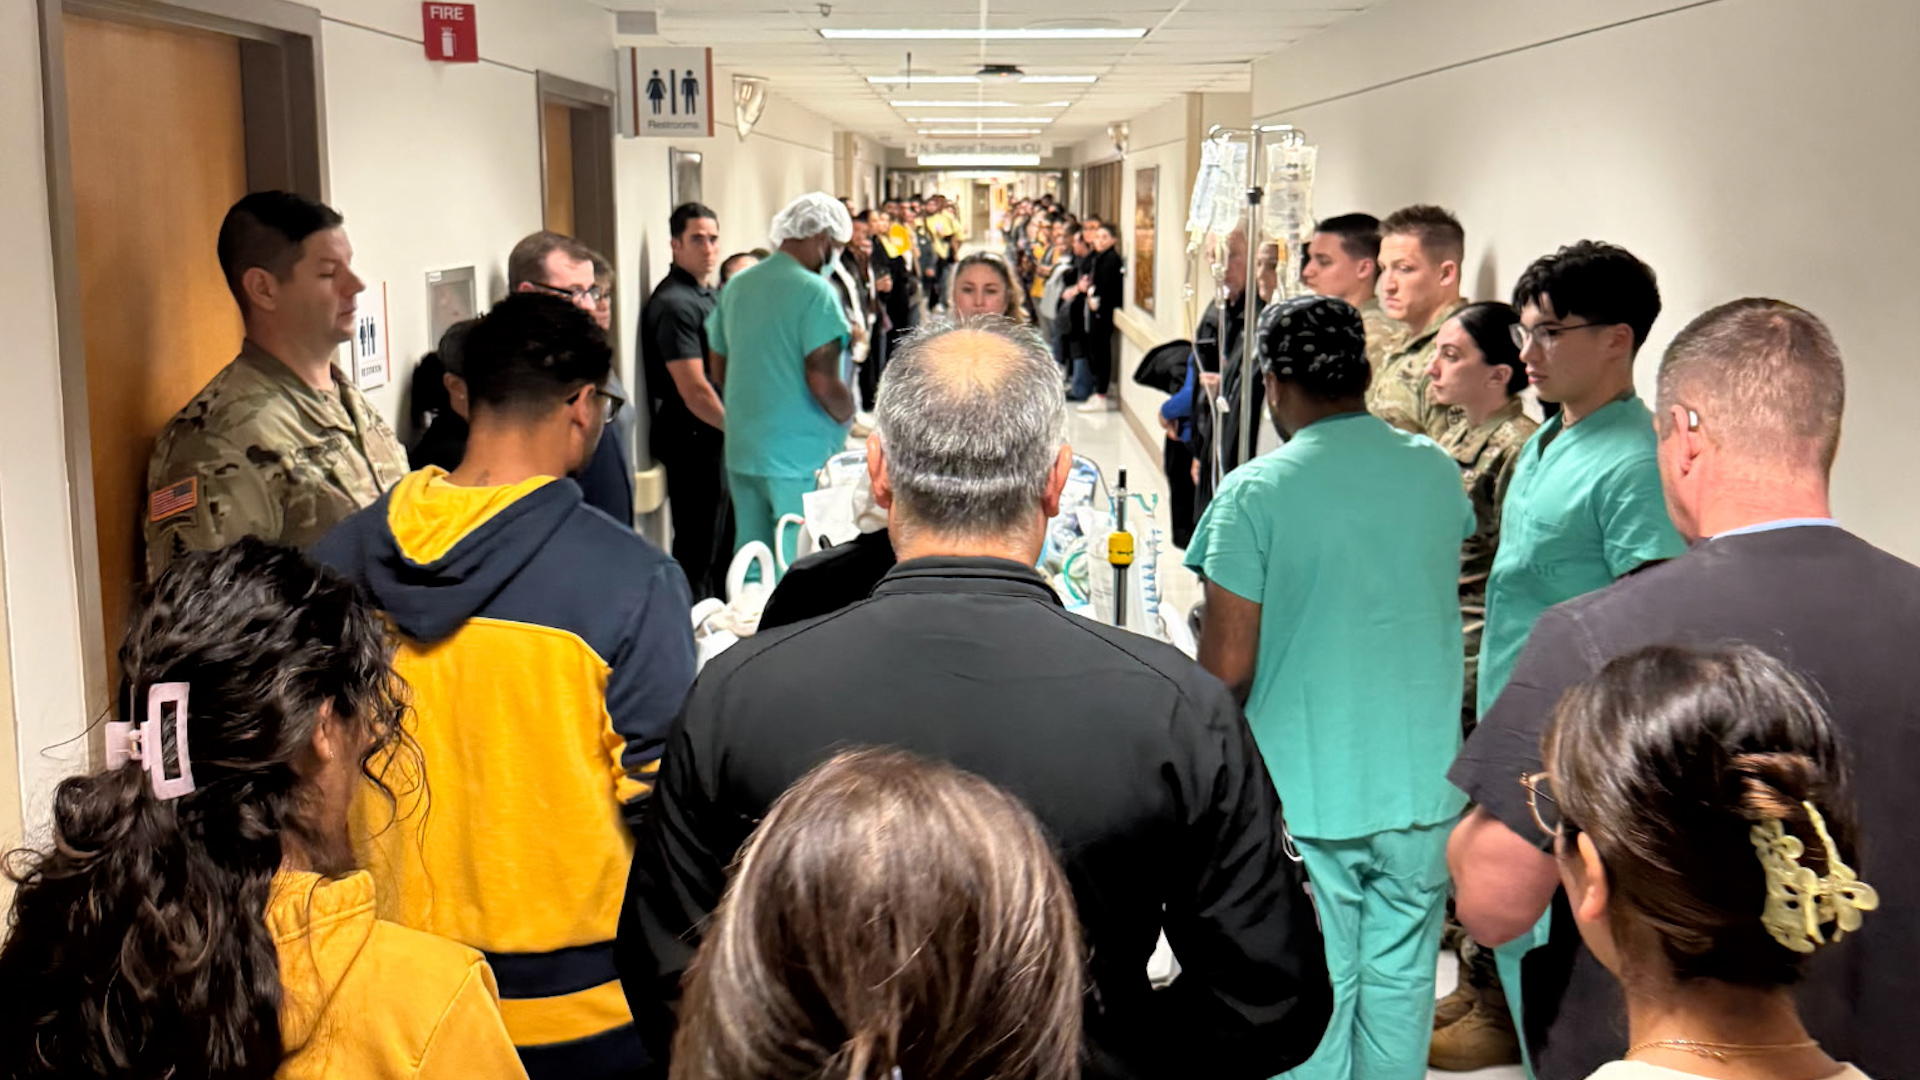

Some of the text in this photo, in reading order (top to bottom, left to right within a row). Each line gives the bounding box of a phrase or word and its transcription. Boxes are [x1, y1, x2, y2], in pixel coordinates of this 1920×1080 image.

[430, 5, 465, 20] FIRE
[647, 119, 699, 130] Restrooms
[934, 142, 976, 154] Surgical
[979, 142, 1018, 153] Trauma
